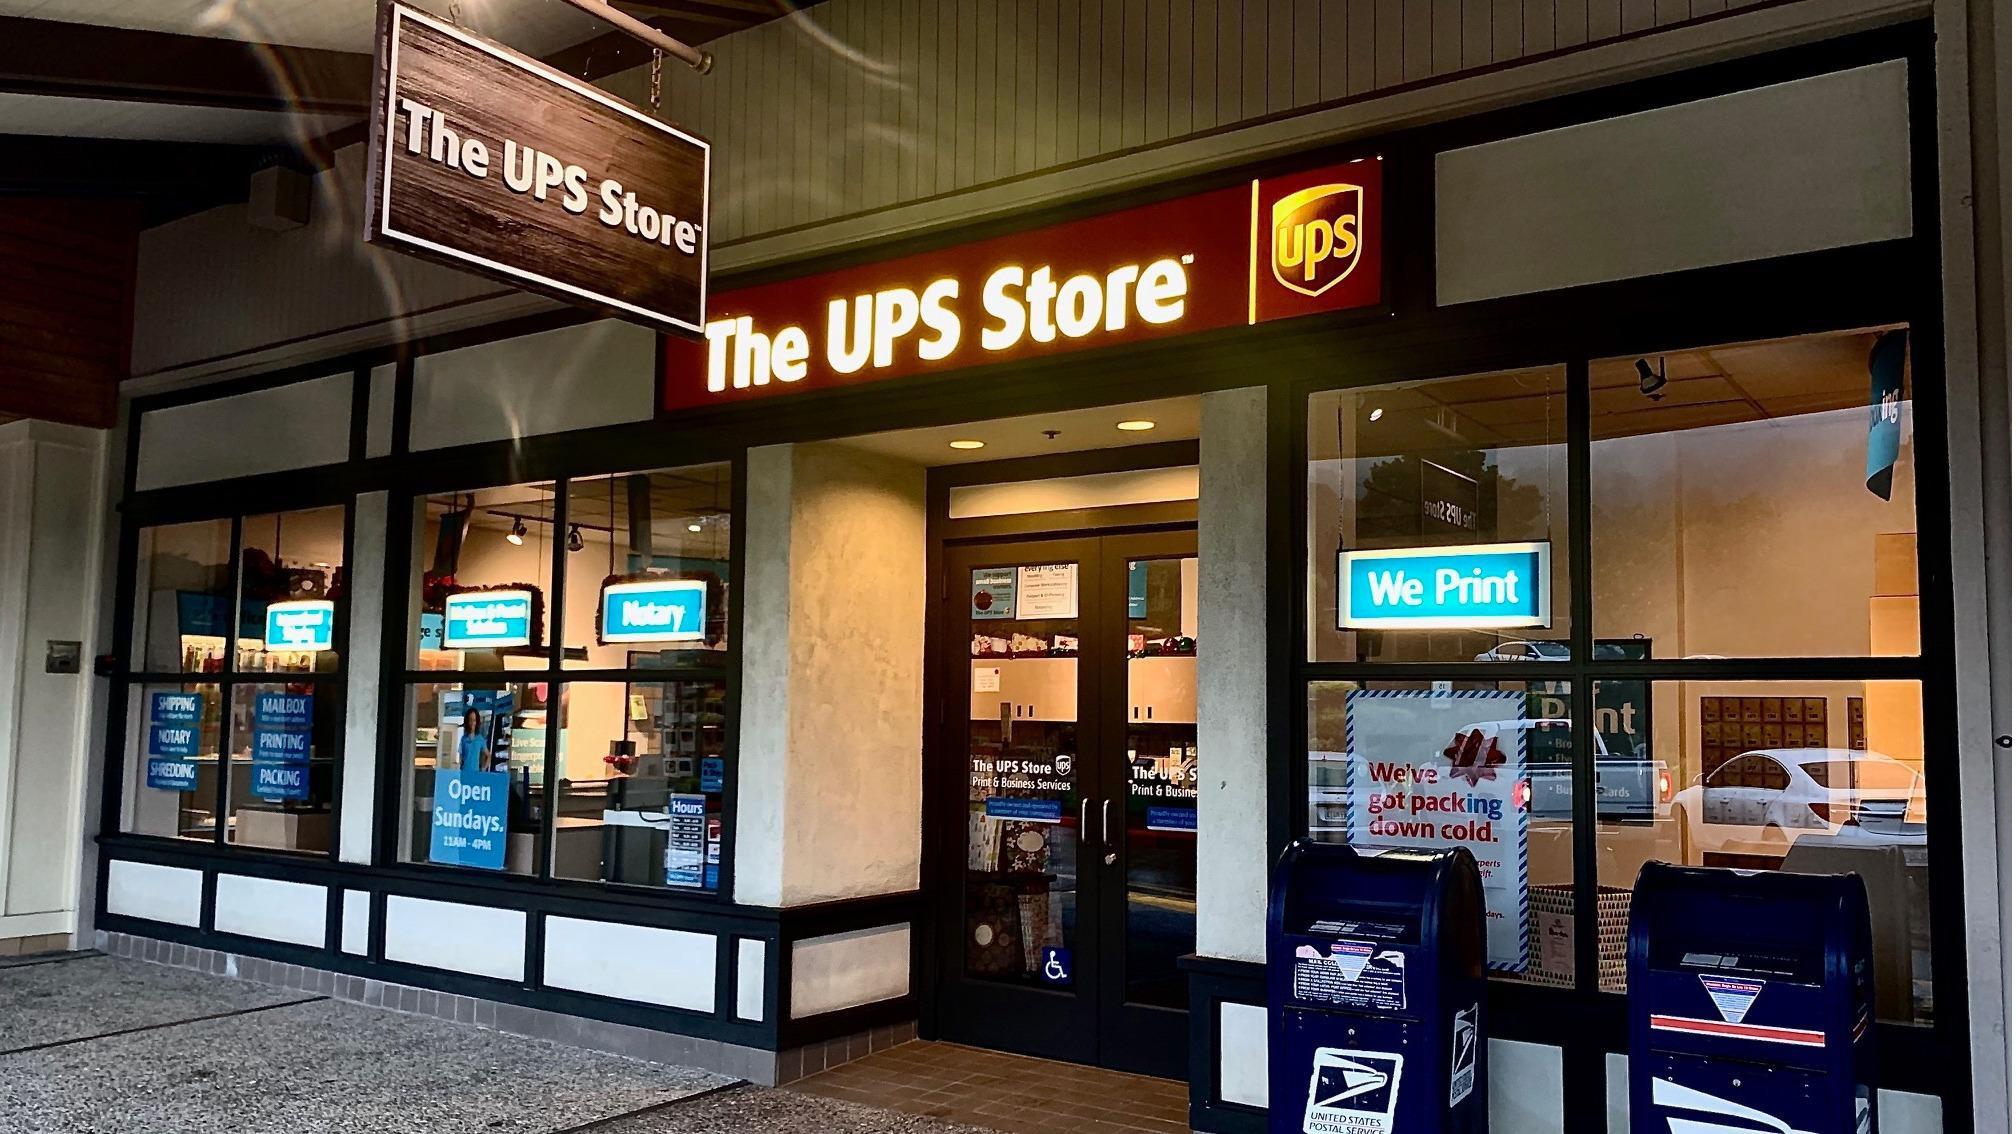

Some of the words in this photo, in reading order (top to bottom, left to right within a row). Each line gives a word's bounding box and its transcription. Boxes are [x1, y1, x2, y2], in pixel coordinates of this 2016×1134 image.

[401, 98, 489, 178] The
[503, 140, 588, 214] UPS
[1278, 213, 1357, 282] ups
[704, 315, 810, 393] The
[826, 278, 961, 376] UPS
[1367, 570, 1424, 606] We
[1435, 567, 1520, 605] Print
[262, 697, 306, 714] MAILBOX
[158, 729, 191, 745] NOTARY
[260, 732, 305, 750] PRINTING
[150, 761, 195, 779] SHREDDING
[973, 759, 993, 772] The
[996, 760, 1019, 773] UPS
[1021, 760, 1052, 774] Store
[1132, 766, 1155, 779] The
[1369, 761, 1438, 784] We've
[260, 767, 301, 786] PACKING
[973, 776, 992, 787] Print
[993, 777, 999, 787] &
[1001, 777, 1035, 789] Business
[1037, 778, 1071, 791] Services
[448, 779, 491, 805] Open
[1132, 784, 1154, 796] Print
[1156, 785, 1163, 796] &
[672, 800, 703, 814] Hours
[1368, 791, 1406, 814] got
[1411, 791, 1503, 820] packing
[435, 806, 504, 837] Sundays.
[1369, 815, 1435, 839] down
[1441, 820, 1499, 843] cold.
[471, 838, 492, 851] 4PM
[1309, 1122, 1344, 1134] POSTAL
[1310, 1112, 1346, 1123] UNITED
[1347, 1115, 1382, 1127] STATES
